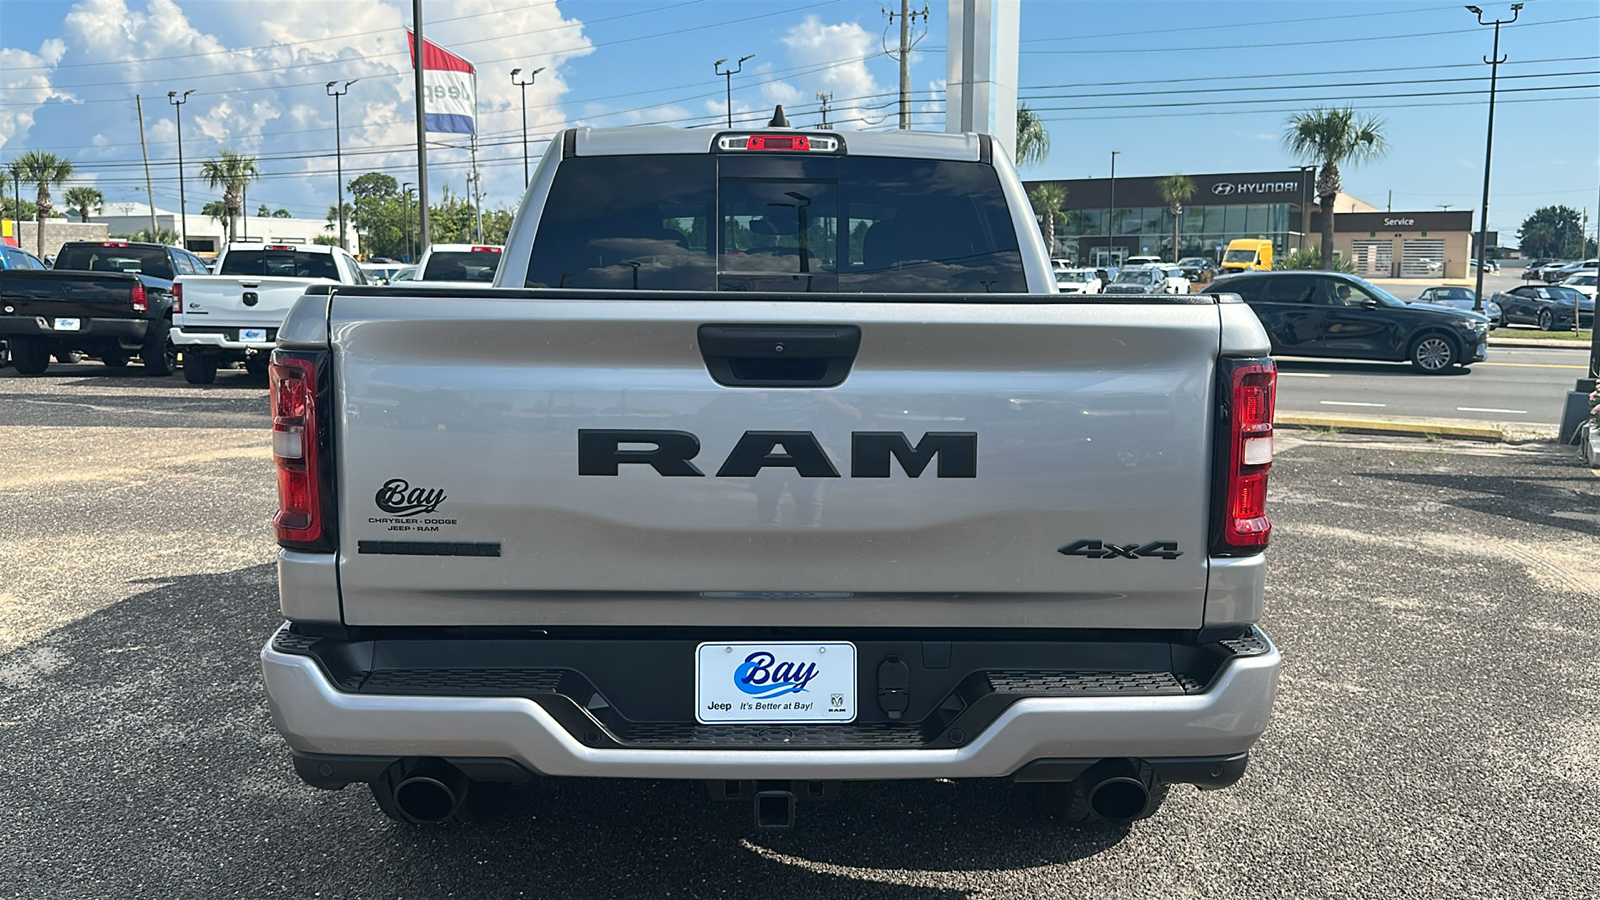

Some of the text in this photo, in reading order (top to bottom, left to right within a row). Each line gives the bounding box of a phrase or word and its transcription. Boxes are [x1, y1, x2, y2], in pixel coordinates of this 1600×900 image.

[1237, 182, 1298, 194] HYUNDAI
[1384, 217, 1414, 227] Service
[578, 429, 977, 478] RAM
[379, 478, 448, 514] Bay
[368, 517, 419, 525] CHRYSLER
[1057, 539, 1184, 560] 4x4
[741, 651, 820, 693] Bay
[707, 701, 732, 712] Jeep
[740, 702, 814, 712] It's Better at Bay!
